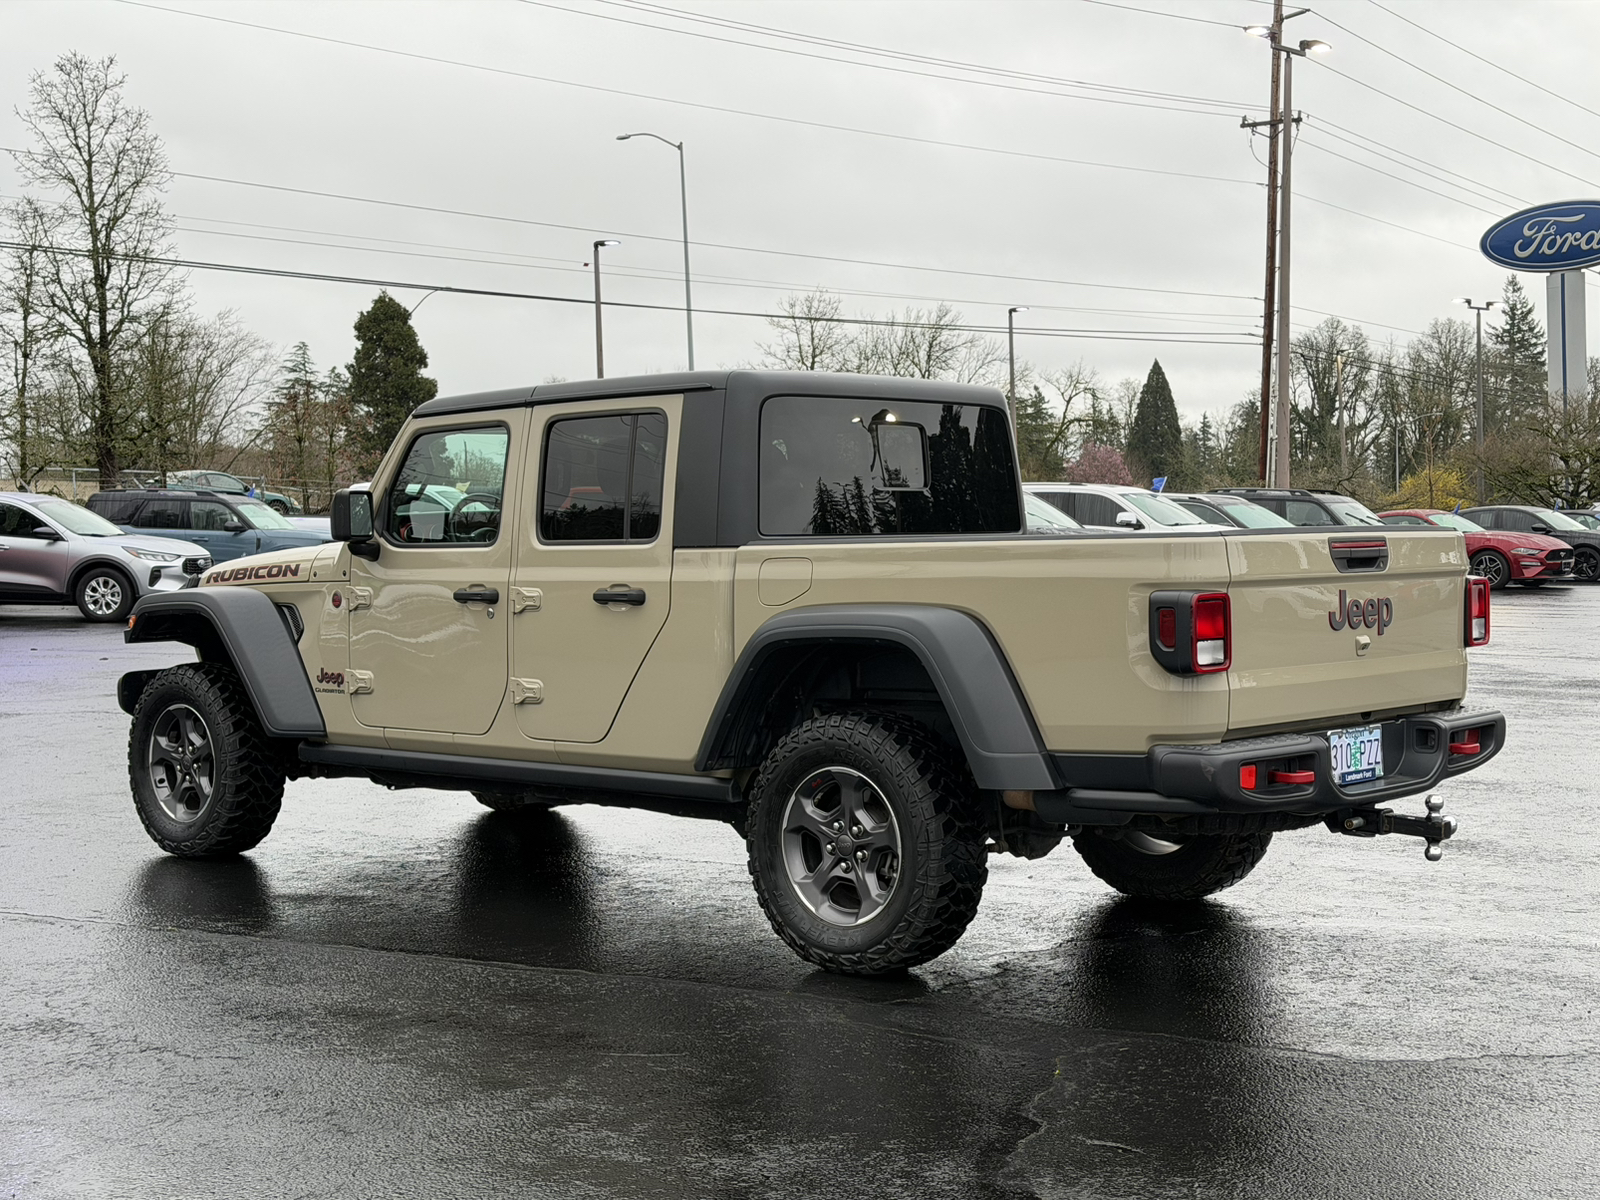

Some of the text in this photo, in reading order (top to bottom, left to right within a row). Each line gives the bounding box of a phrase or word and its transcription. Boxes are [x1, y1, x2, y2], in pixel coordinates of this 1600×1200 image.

[206, 564, 300, 584] RUBICON
[1328, 589, 1393, 635] Jeep
[316, 667, 345, 688] Jeep
[834, 746, 881, 778] KENDA
[1332, 738, 1380, 771] 310 PZZ
[1345, 772, 1363, 782] Landmark
[1363, 770, 1372, 779] Ford
